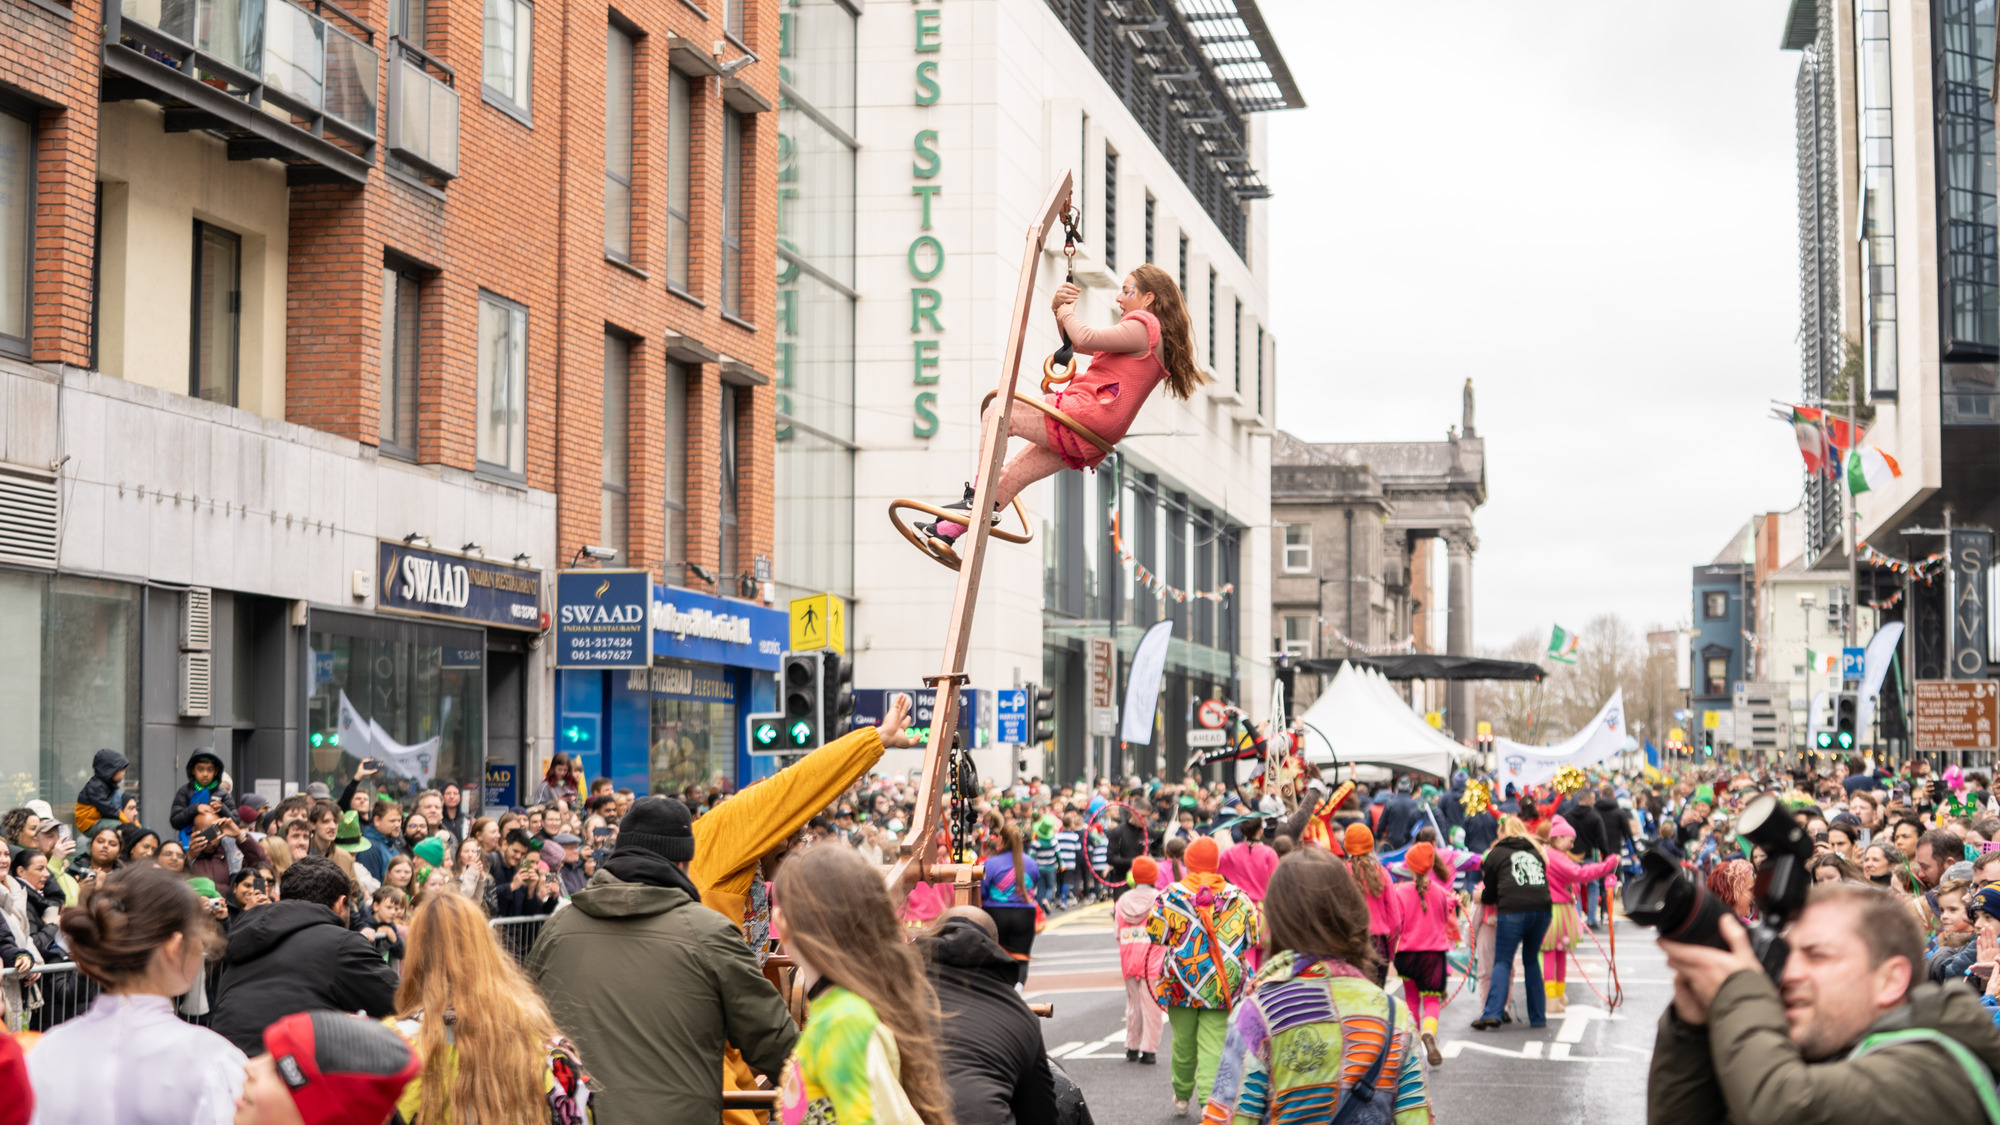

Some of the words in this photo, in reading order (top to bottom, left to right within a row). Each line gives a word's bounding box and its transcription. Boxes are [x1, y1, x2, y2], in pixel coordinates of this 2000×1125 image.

[914, 0, 942, 107] ES
[908, 130, 945, 438] STORES
[402, 555, 469, 608] SWAAD
[468, 567, 494, 588] INDIAN
[495, 572, 538, 596] RESTAURANT
[561, 604, 644, 624] SWAAD
[1957, 548, 1982, 674] SAVO
[563, 625, 591, 633] INDIAN
[593, 625, 641, 633] RESTAURANT
[571, 637, 633, 648] 061-317424
[571, 650, 633, 661] 061-467627
[651, 666, 693, 695] FITZGERALD
[694, 678, 735, 700] ELECTRICAL
[1192, 731, 1221, 743] AHEAD
[485, 770, 511, 782] AAD
